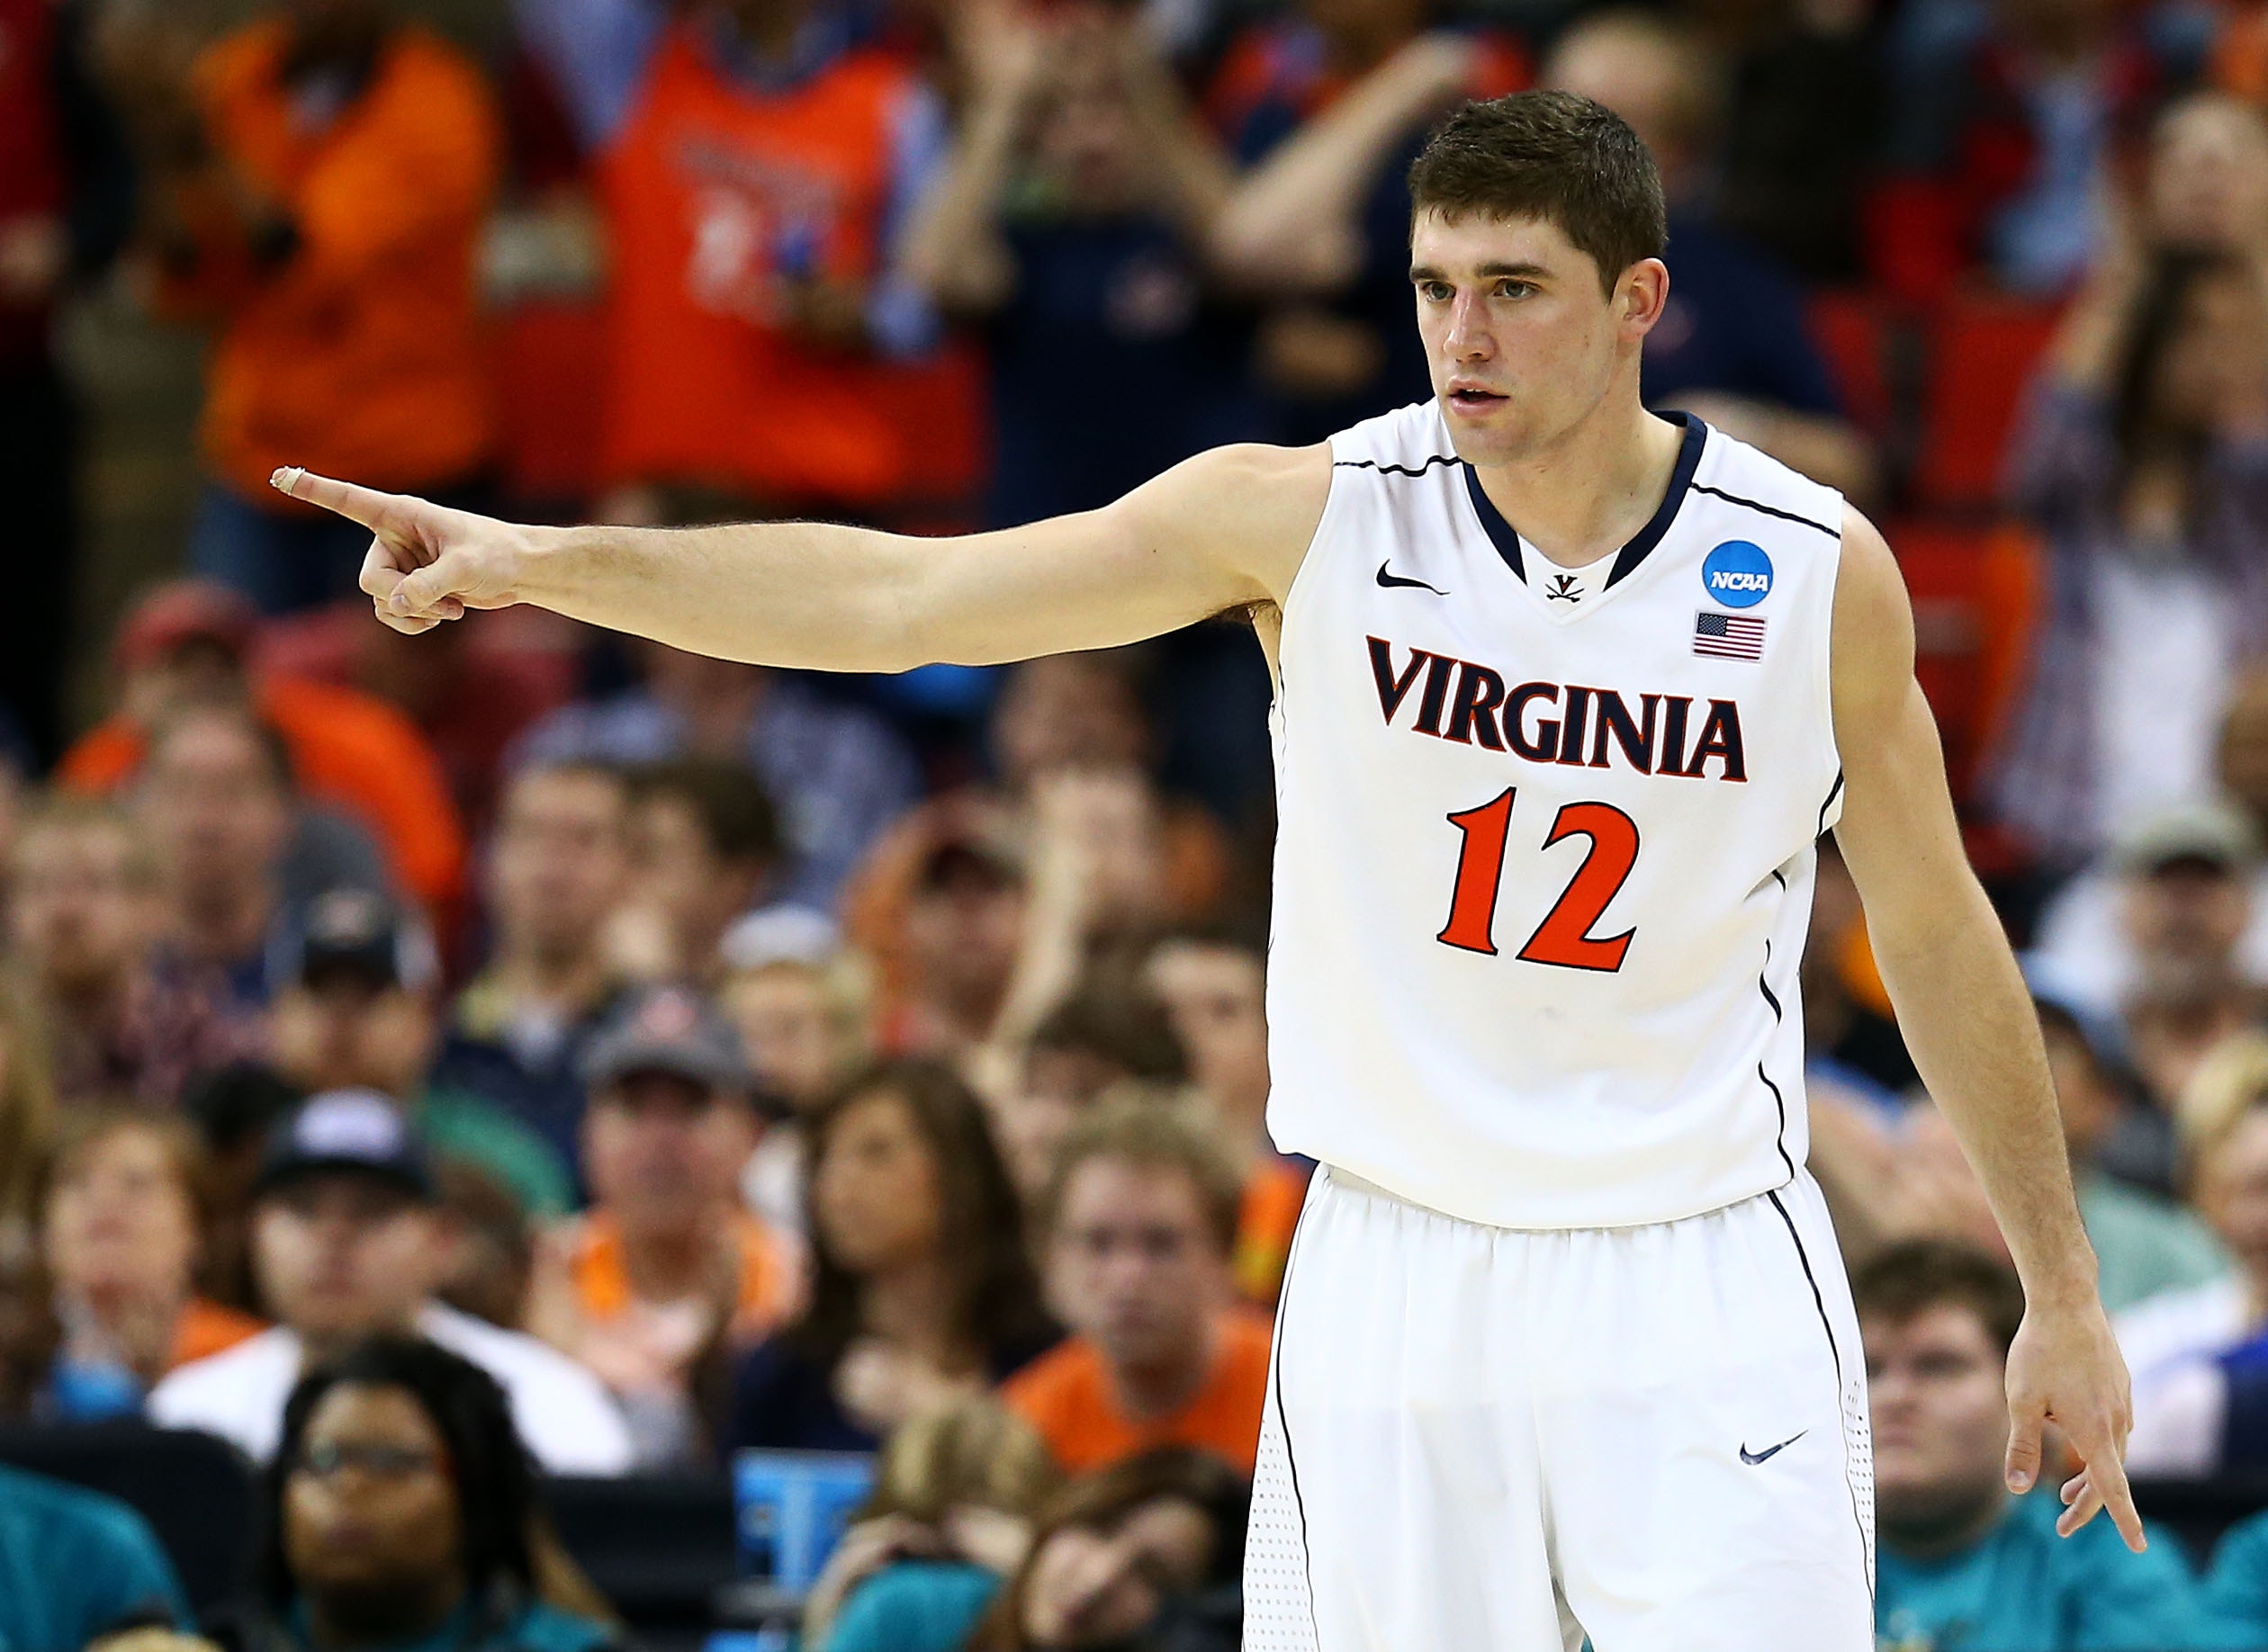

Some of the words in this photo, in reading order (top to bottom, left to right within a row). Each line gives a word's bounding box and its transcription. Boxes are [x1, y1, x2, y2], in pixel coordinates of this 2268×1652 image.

[1710, 570, 1768, 592] NCAA
[1365, 634, 1748, 783] VIRGINIA
[1436, 786, 1640, 973] 12
